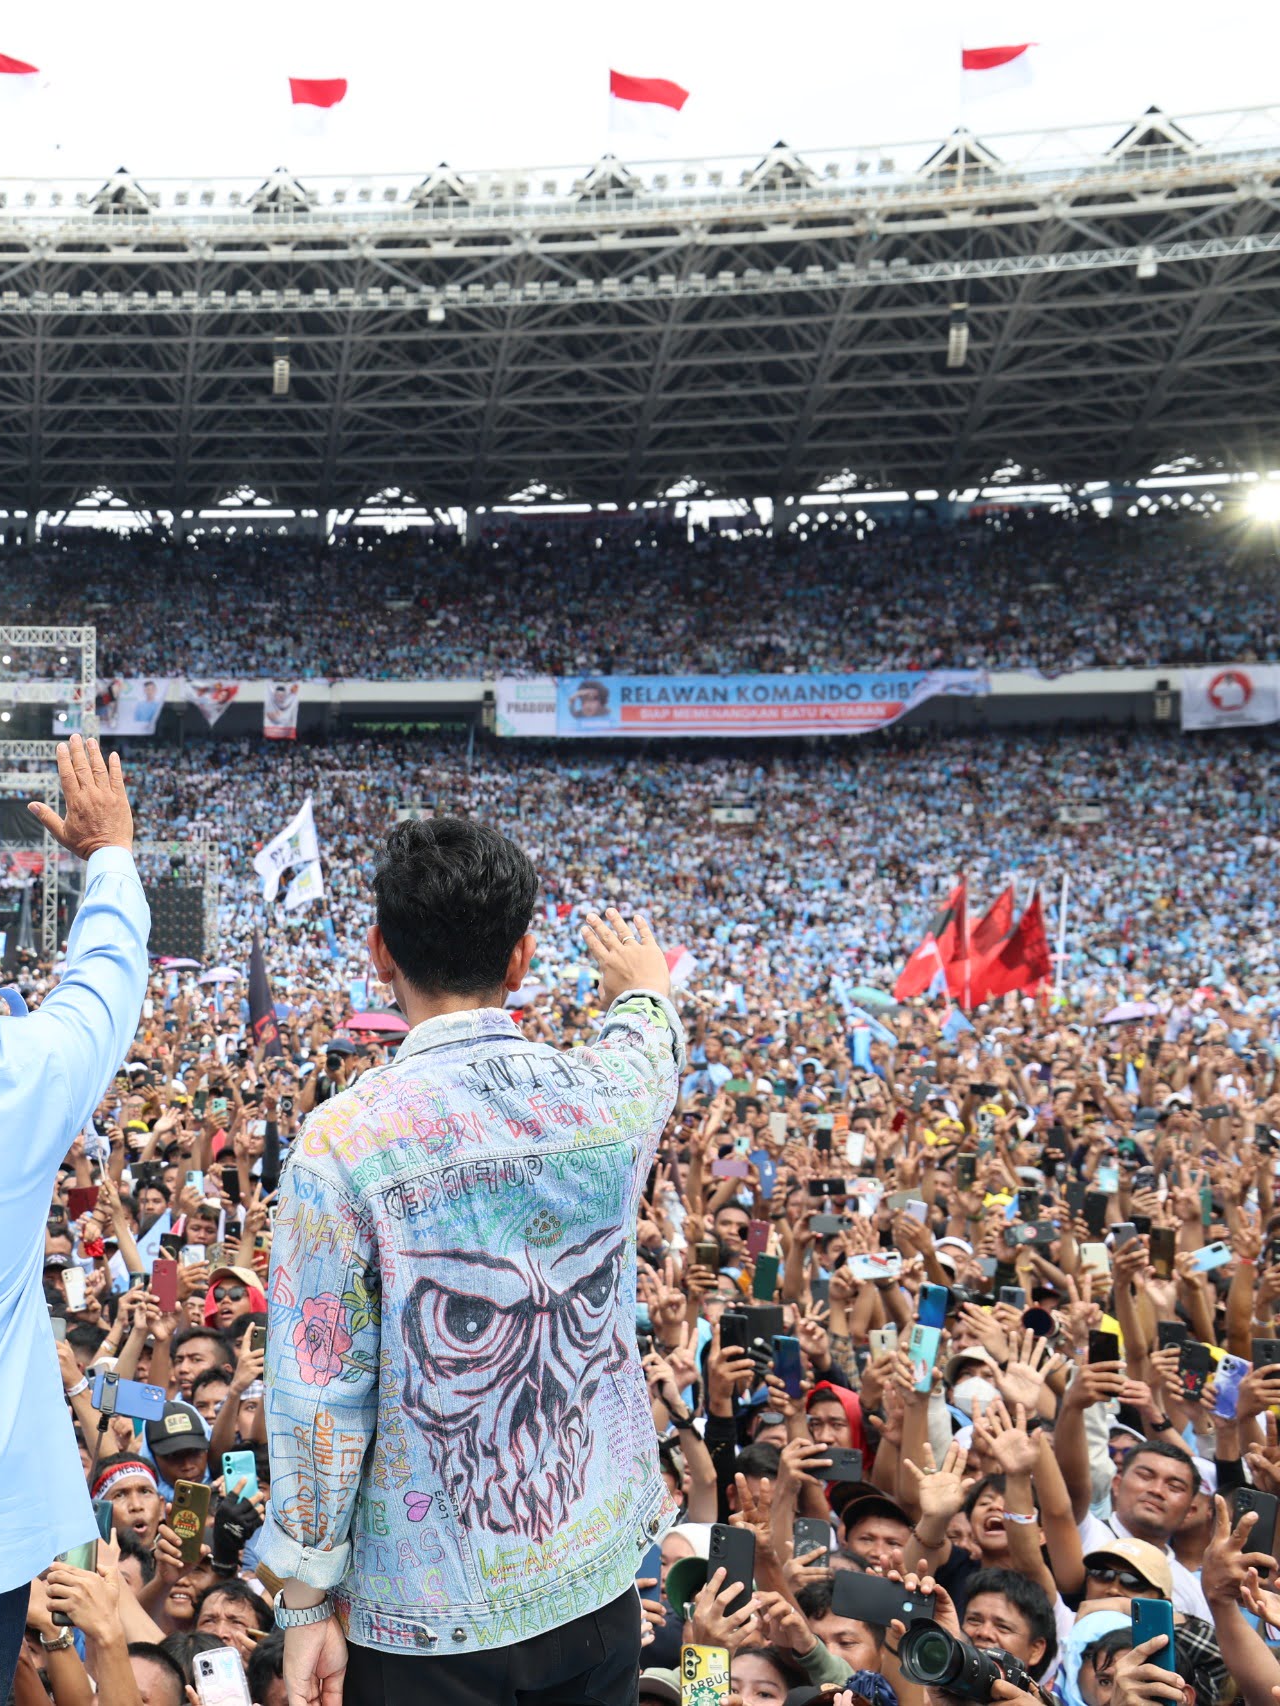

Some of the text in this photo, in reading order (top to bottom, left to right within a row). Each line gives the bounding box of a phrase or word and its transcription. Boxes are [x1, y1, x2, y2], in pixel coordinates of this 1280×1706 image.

[621, 686, 729, 704] RELAWAN
[736, 682, 863, 702] KOMANDO
[640, 704, 886, 720] SIAP MEMENANGKAN SATU PUTARAN
[293, 1425, 317, 1537] ANOTHER
[433, 1489, 449, 1520] LOVE
